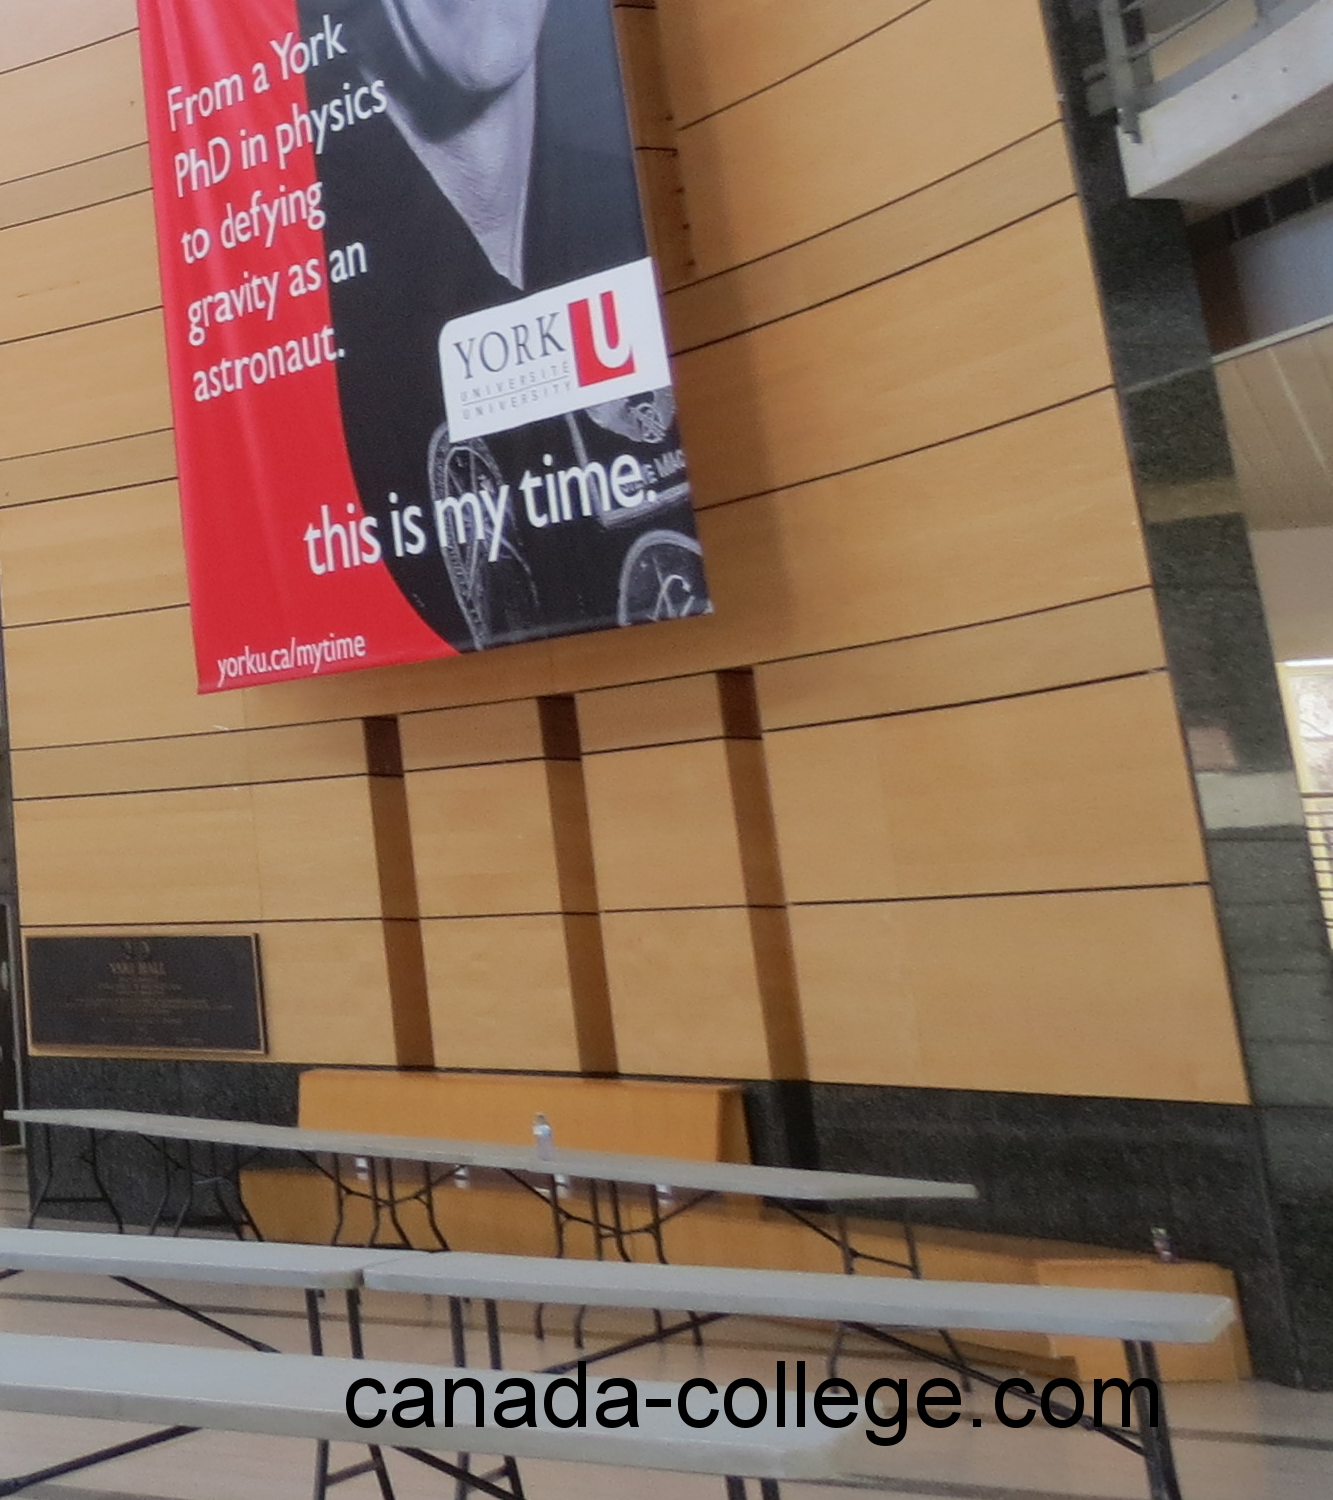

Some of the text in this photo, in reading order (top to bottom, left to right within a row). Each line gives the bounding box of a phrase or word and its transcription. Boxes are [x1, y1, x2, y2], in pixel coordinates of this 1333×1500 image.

[167, 14, 348, 131] From a York
[174, 80, 388, 198] PhD in physics
[181, 181, 326, 264] to defying
[188, 241, 367, 346] gravity as an
[193, 325, 346, 402] astronaut.
[453, 312, 566, 380] YORK
[302, 501, 383, 576] this
[389, 491, 427, 558] is
[434, 484, 511, 563] my
[518, 453, 658, 529] time.
[216, 633, 366, 688] yorku.ca/mytime
